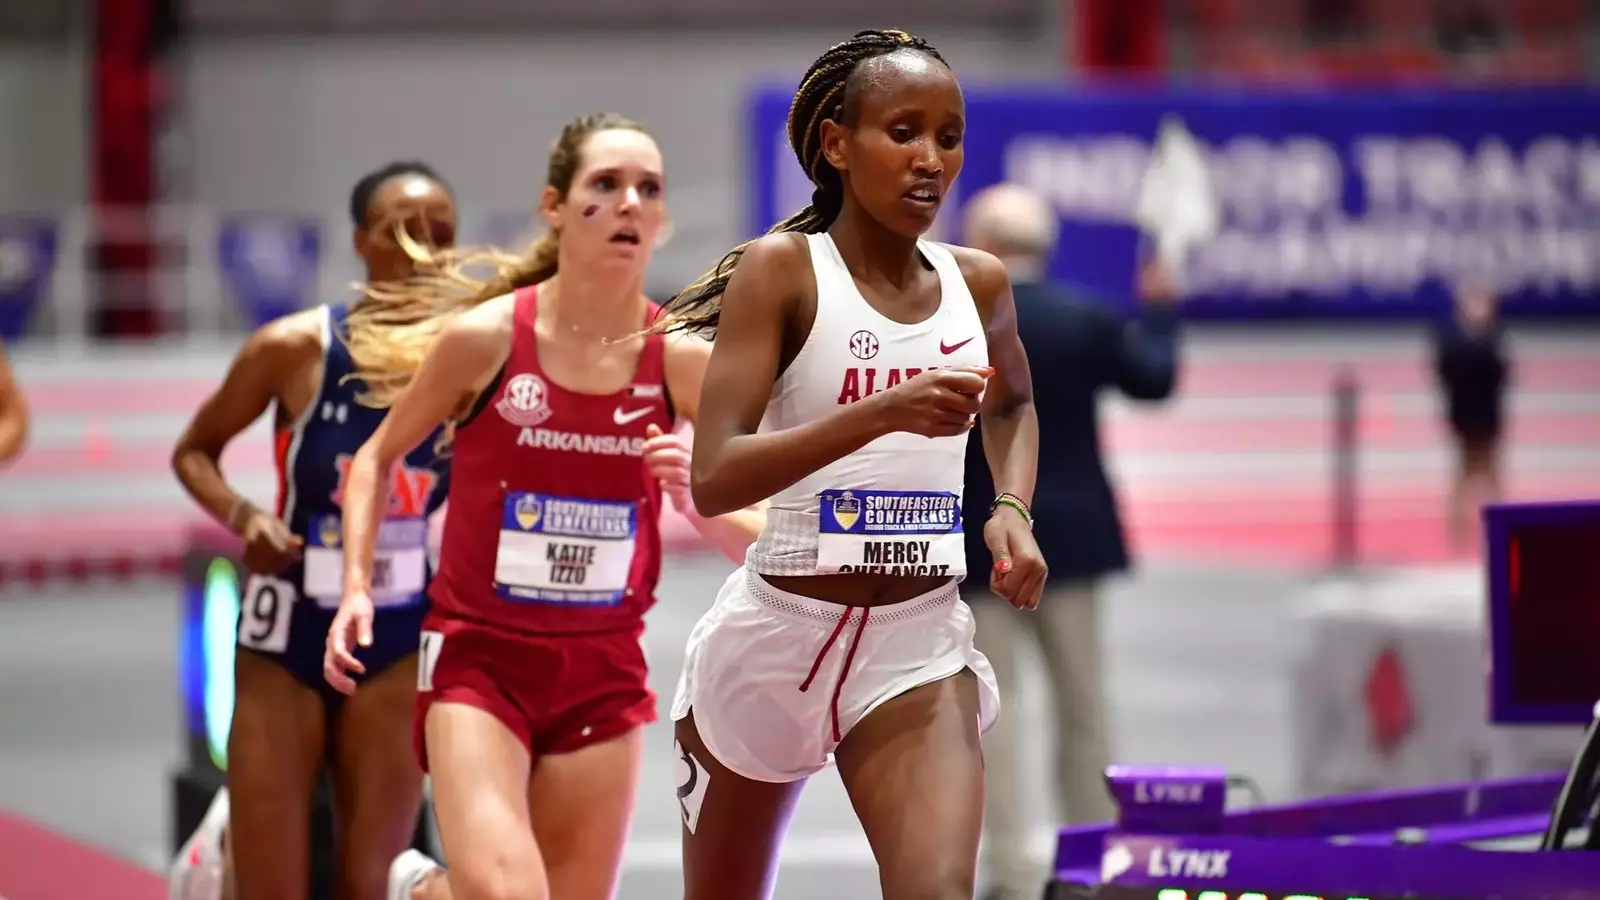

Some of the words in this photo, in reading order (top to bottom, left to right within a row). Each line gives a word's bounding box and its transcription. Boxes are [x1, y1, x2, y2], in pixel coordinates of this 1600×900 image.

[1006, 136, 1342, 222] INDOR
[850, 330, 879, 360] SEC
[507, 376, 545, 412] SEC
[516, 427, 645, 456] ARKANSAS
[865, 496, 955, 510] SOUTHEASTERN
[865, 509, 955, 524] CONFERENCE
[546, 542, 597, 565] KATIE
[864, 541, 930, 564] MERCY
[549, 564, 587, 585] IZZO
[250, 585, 279, 642] 9
[1148, 847, 1232, 879] LYNX
